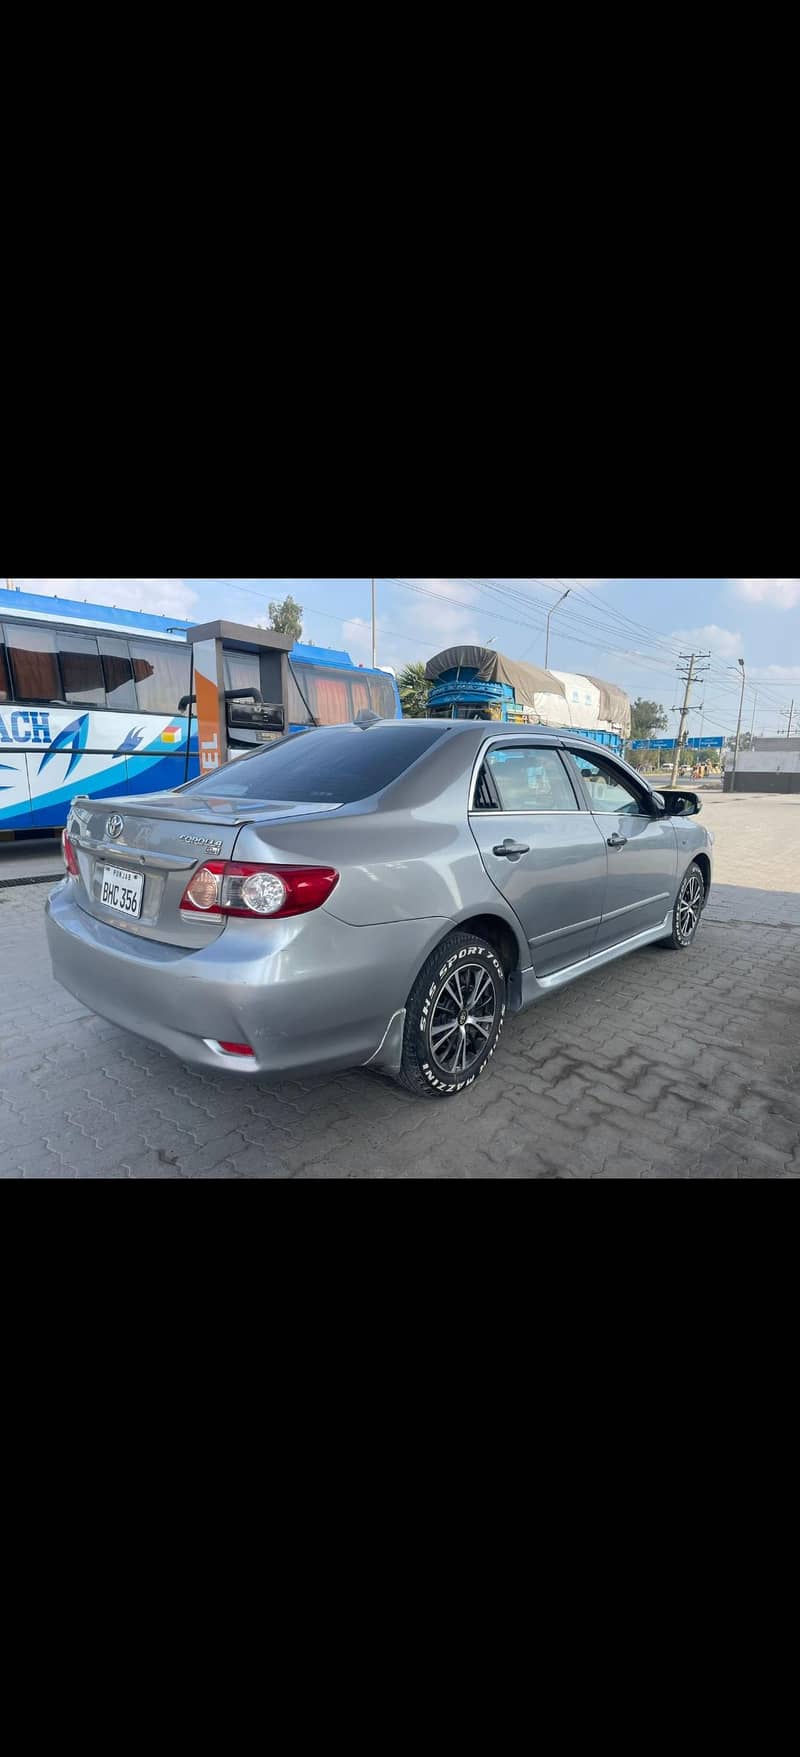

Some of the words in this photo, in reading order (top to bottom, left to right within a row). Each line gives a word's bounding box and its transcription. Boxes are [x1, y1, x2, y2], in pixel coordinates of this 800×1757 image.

[113, 870, 131, 881] PUNJAB
[102, 882, 120, 906] BHC
[120, 888, 138, 913] 356
[439, 946, 485, 980] SPORT
[422, 1063, 475, 1093] MAZZINI
